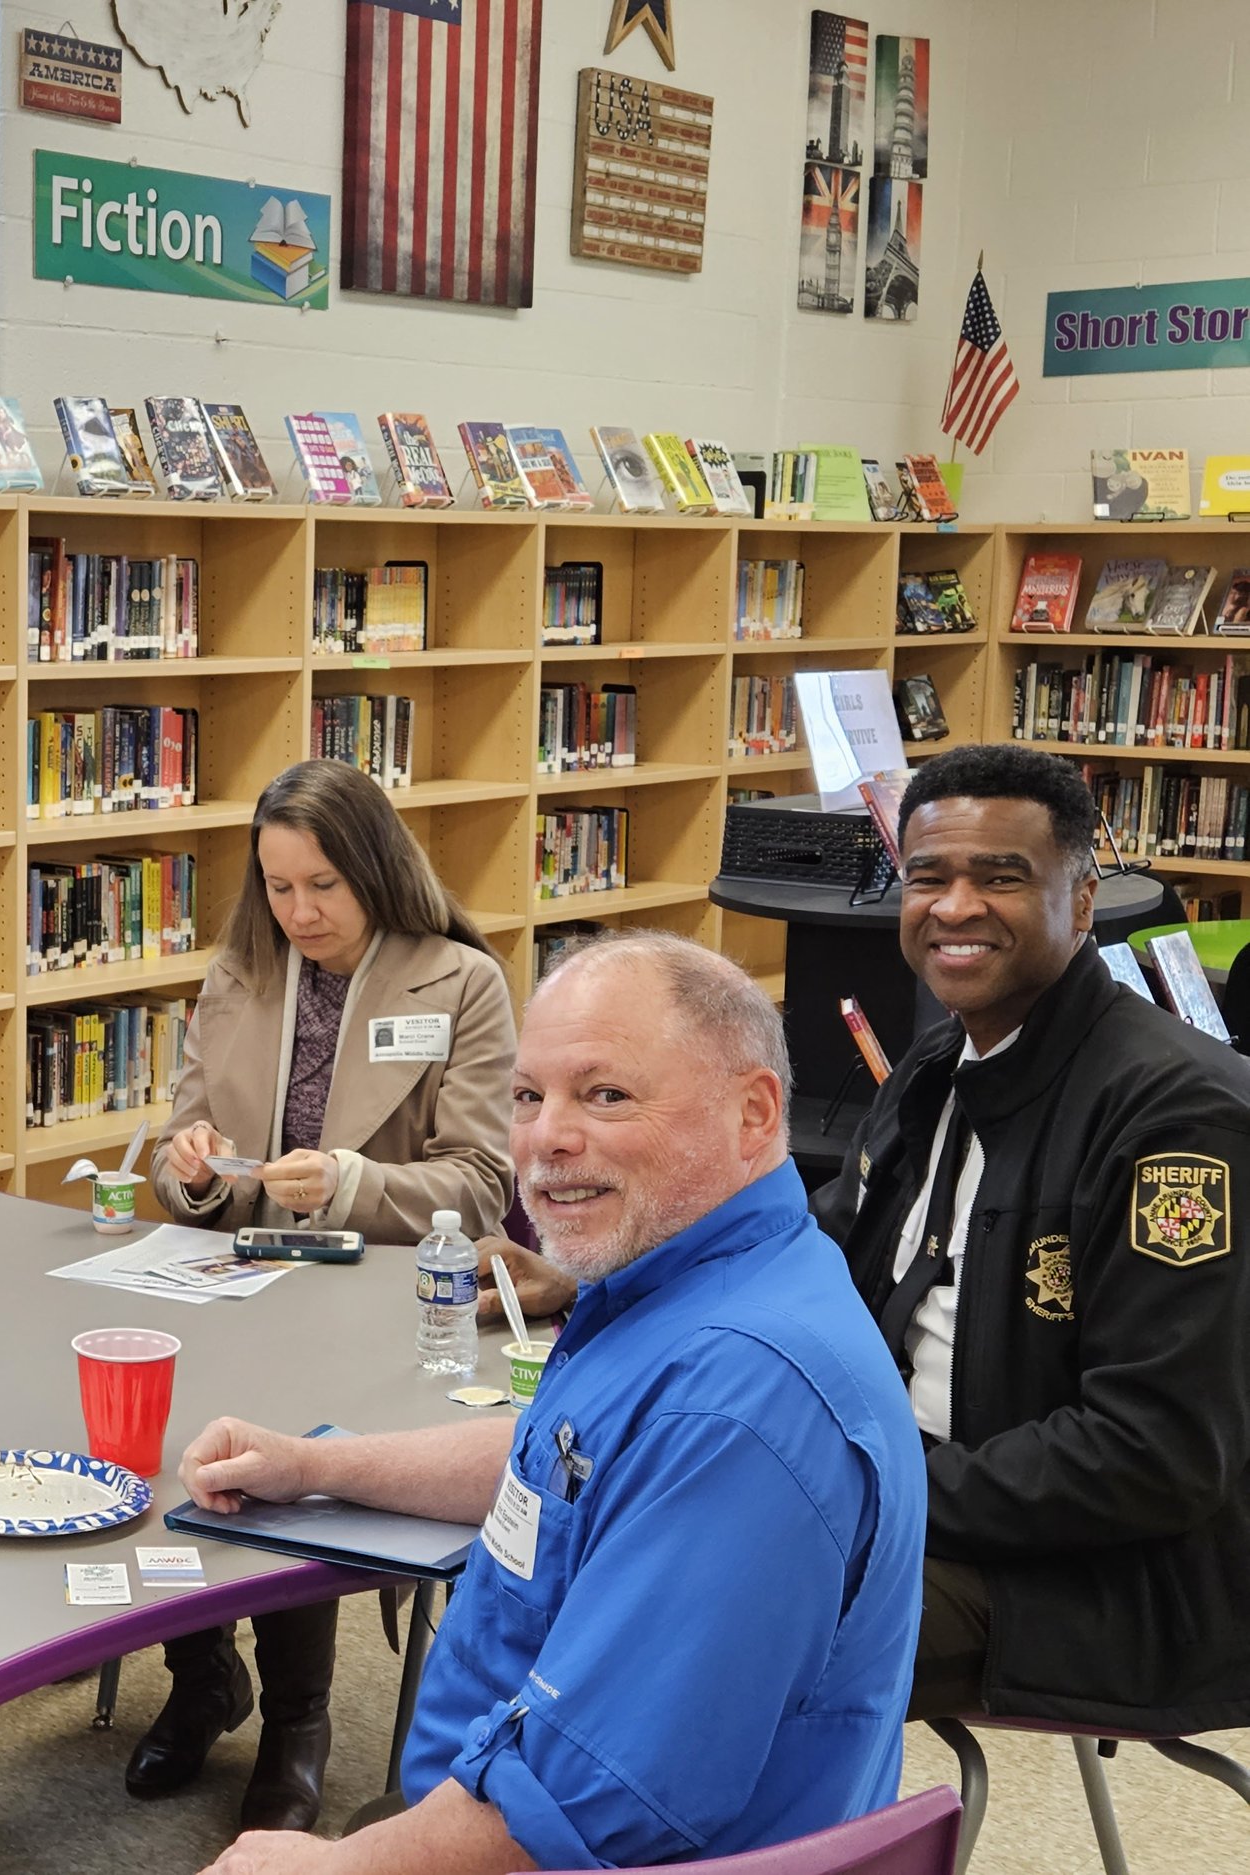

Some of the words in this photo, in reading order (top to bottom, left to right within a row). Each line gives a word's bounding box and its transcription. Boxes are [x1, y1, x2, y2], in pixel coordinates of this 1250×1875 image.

[29, 62, 116, 92] AMERICA
[595, 72, 654, 145] USA
[52, 174, 222, 264] Fiction
[1055, 310, 1159, 352] Short
[1167, 304, 1250, 344] Stor
[400, 445, 436, 466] REAL
[1132, 451, 1184, 461] IVAN
[372, 720, 381, 771] JACKPOT
[850, 728, 878, 745] RVIVE
[1141, 1166, 1223, 1185] SHERIFF
[1158, 1189, 1193, 1202] ARUNDEL
[511, 1366, 542, 1383] CTIVI
[504, 1549, 525, 1569] School
